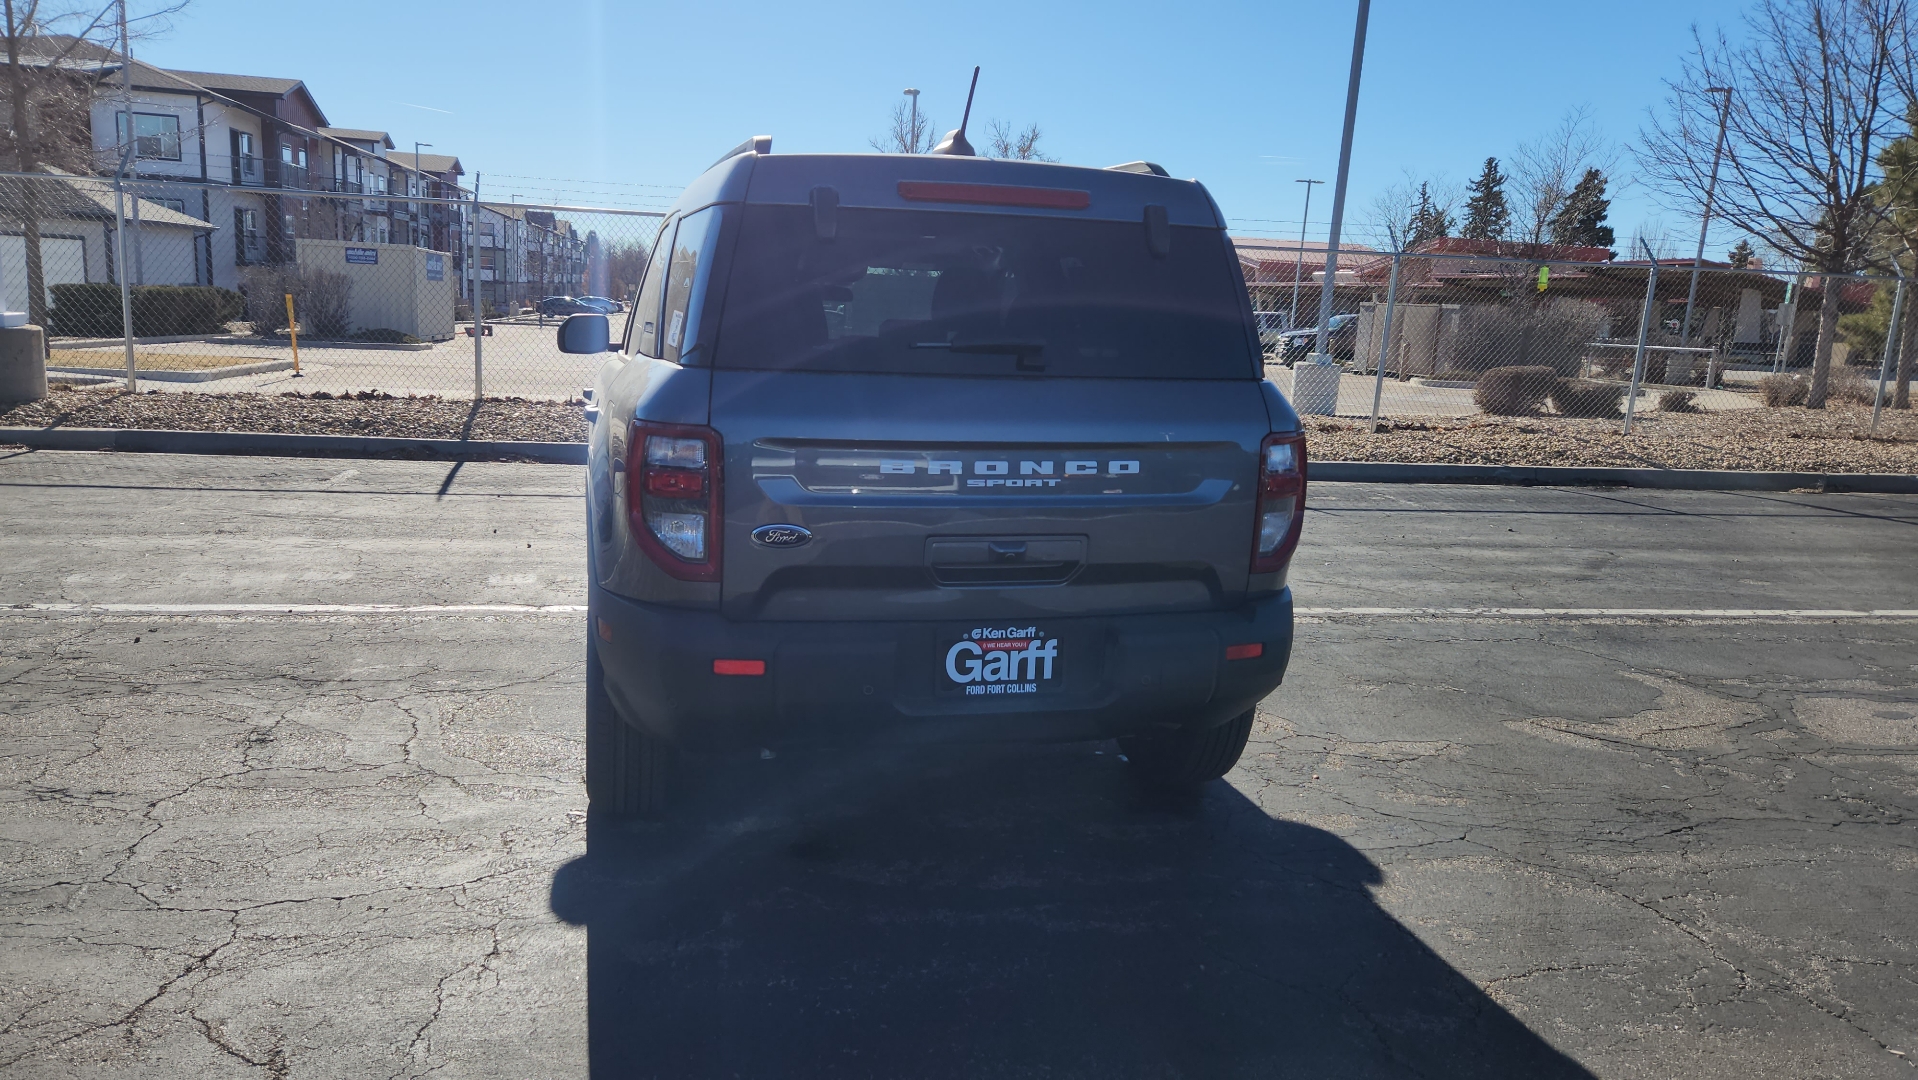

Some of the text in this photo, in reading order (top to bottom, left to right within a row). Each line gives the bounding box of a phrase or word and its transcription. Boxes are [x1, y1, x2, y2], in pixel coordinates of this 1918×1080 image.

[880, 460, 1140, 475] BRONCO
[966, 479, 1061, 487] SPORT
[765, 529, 799, 543] Ford
[982, 626, 1037, 639] Ken Garff
[945, 639, 1058, 684] Garff
[966, 683, 1037, 695] FORD FORT COLLINS
